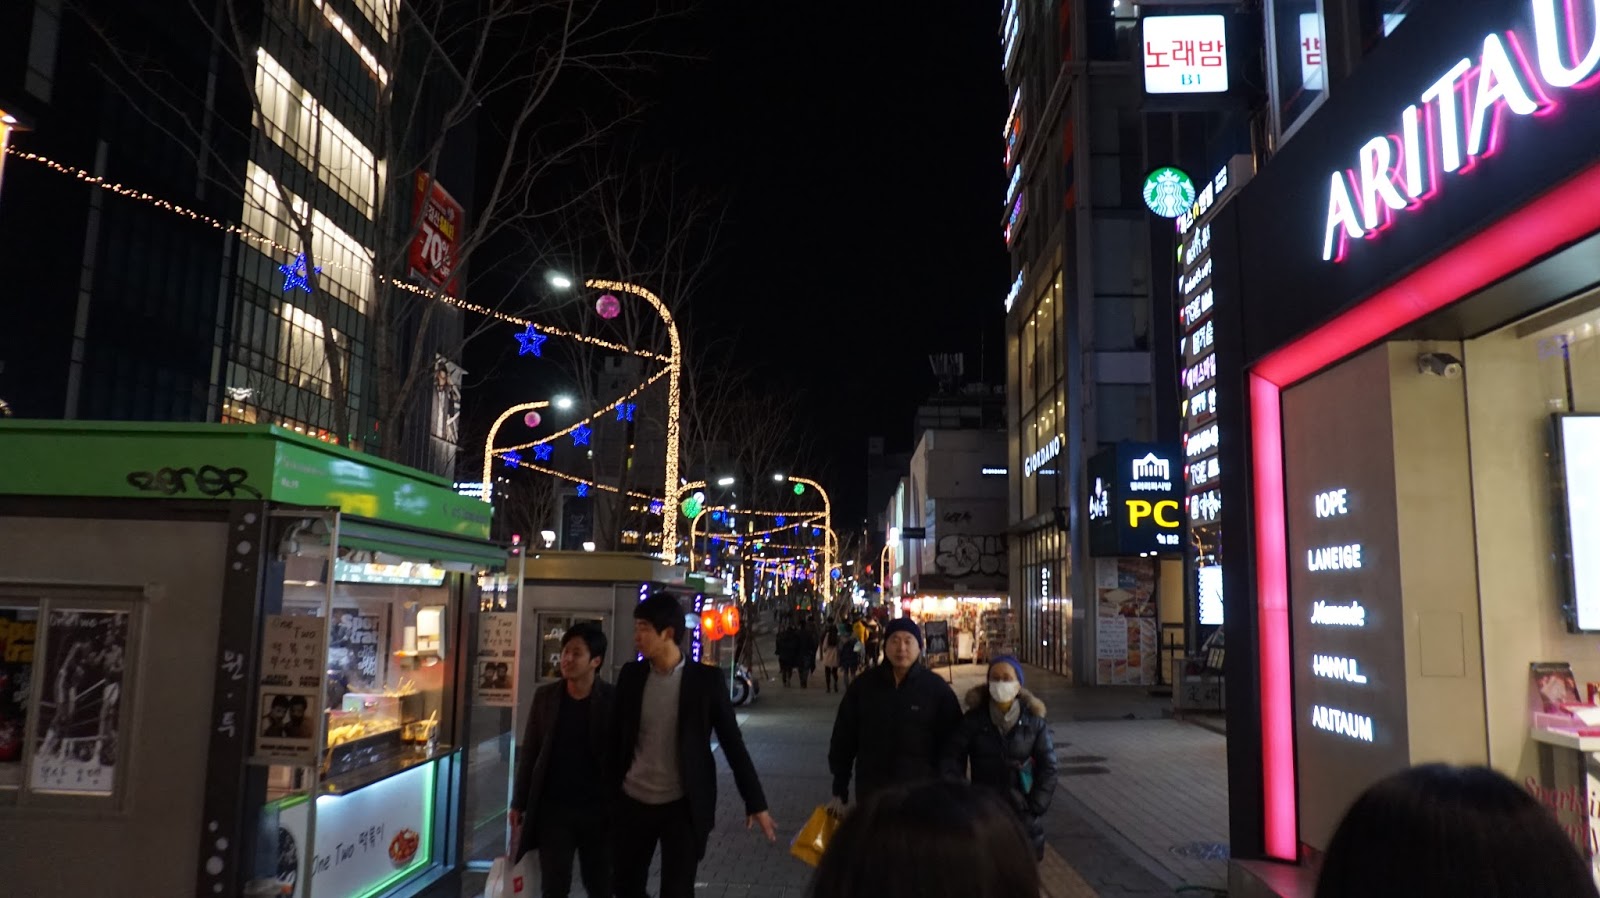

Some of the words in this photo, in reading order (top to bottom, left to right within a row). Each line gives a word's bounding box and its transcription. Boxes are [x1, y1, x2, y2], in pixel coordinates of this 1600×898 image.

[1146, 40, 1224, 68] 노래밤
[1181, 74, 1201, 86] B1
[1024, 435, 1060, 478] GIORDANO
[1125, 500, 1180, 528] PC
[1315, 488, 1347, 518] IOPE
[1307, 544, 1362, 571] LANEIGE
[1313, 654, 1367, 684] HANYUL
[1312, 705, 1373, 742] ARITAUM
[335, 843, 355, 866] Two
[358, 823, 385, 853] 떡볶이
